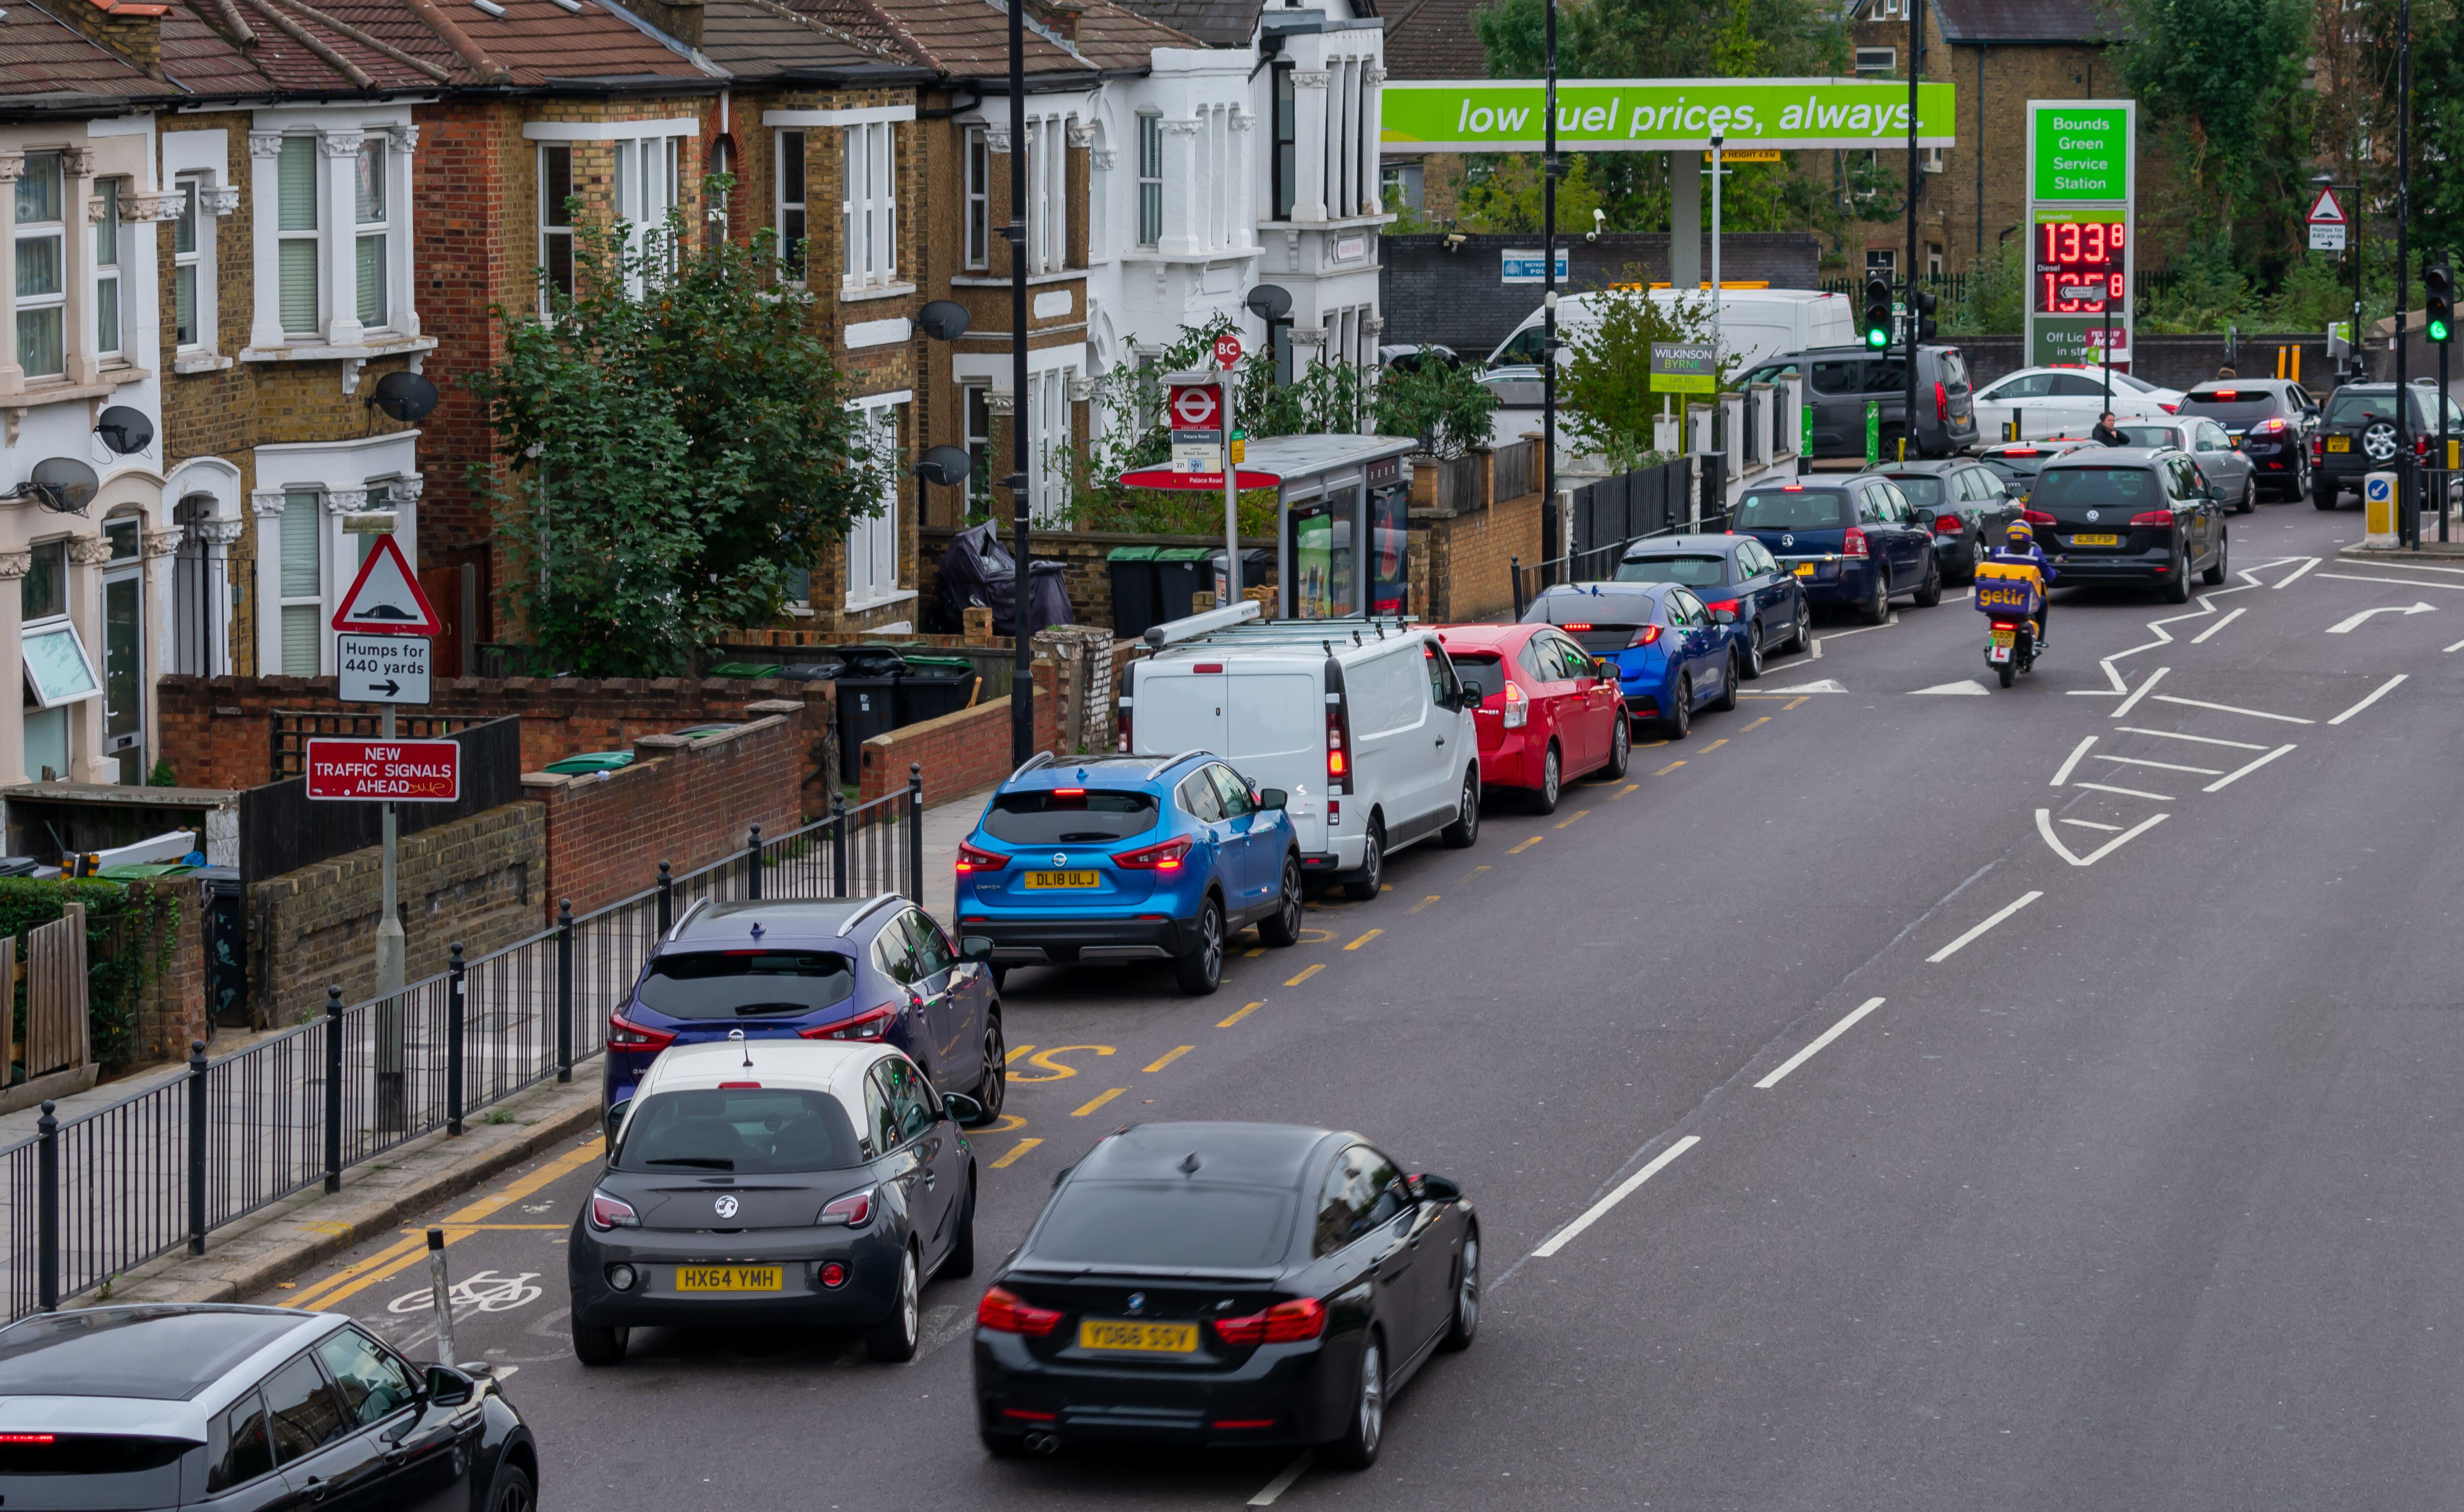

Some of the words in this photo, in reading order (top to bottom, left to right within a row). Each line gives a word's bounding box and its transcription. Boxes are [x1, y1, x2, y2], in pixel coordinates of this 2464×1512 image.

[1458, 98, 1530, 133] low
[1629, 97, 1763, 138] prices,
[1779, 96, 1924, 137] always.
[2054, 117, 2109, 130] Bounds
[2059, 136, 2103, 149] Green
[2054, 157, 2108, 170] Service
[2055, 176, 2106, 189] Station
[2046, 332, 2064, 342] Off
[2093, 337, 2117, 346] hee
[1219, 342, 1236, 355] BC
[1655, 348, 1712, 359] WILKINSON
[2057, 346, 2067, 356] in
[1665, 359, 1700, 369] BYRNE
[1979, 588, 2025, 606] getir
[346, 642, 397, 658] Humps
[403, 644, 424, 657] for
[1996, 647, 2004, 658] L
[345, 659, 378, 672] 440
[384, 662, 424, 675] yards
[365, 747, 400, 760] NEW
[314, 763, 378, 777] TRAFFIC
[385, 764, 451, 778] SIGNALS
[356, 780, 409, 793] AHEAD
[1036, 873, 1065, 886] DL18
[1069, 873, 1094, 885] ULJ
[685, 1270, 732, 1287] HX64
[739, 1270, 774, 1287] YMH
